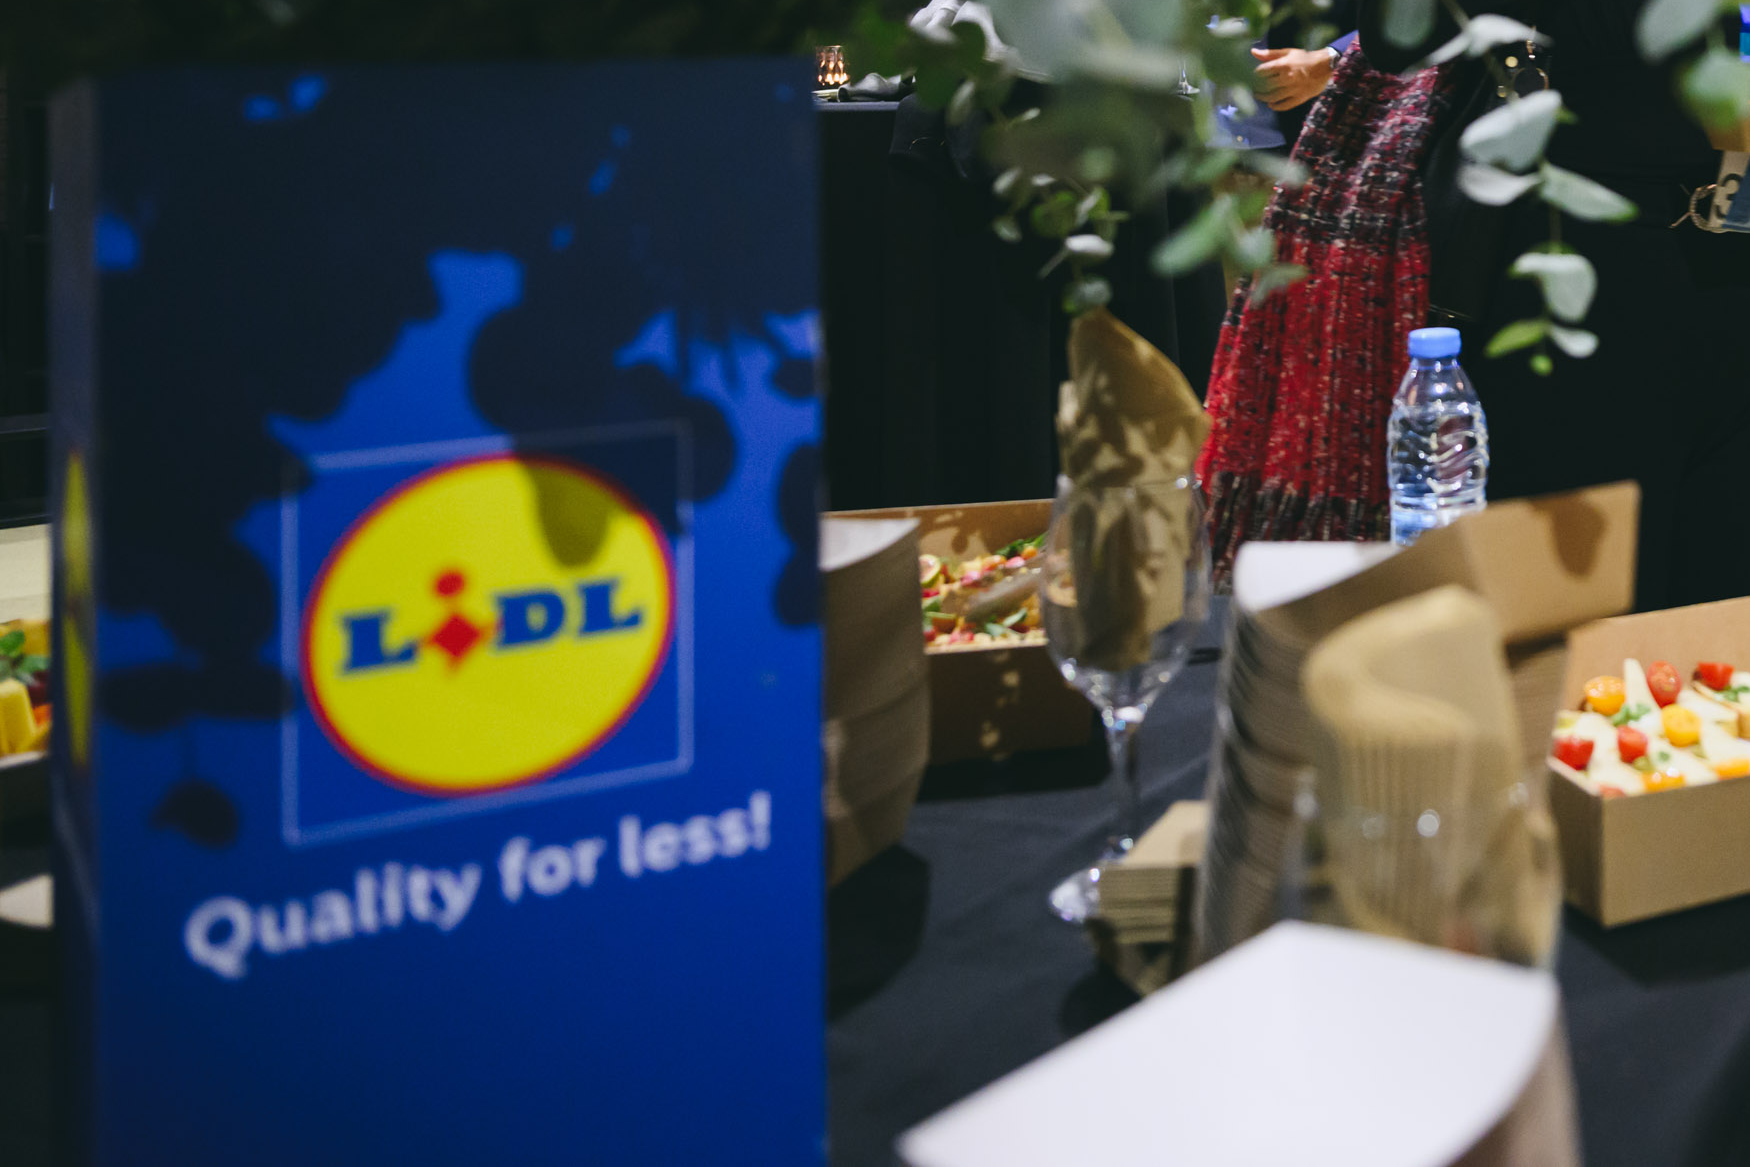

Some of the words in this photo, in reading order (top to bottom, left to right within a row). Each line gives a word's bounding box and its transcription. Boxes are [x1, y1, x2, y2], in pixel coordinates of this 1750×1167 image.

[184, 861, 483, 981] Quality
[500, 835, 606, 904] for
[619, 789, 772, 879] less!
